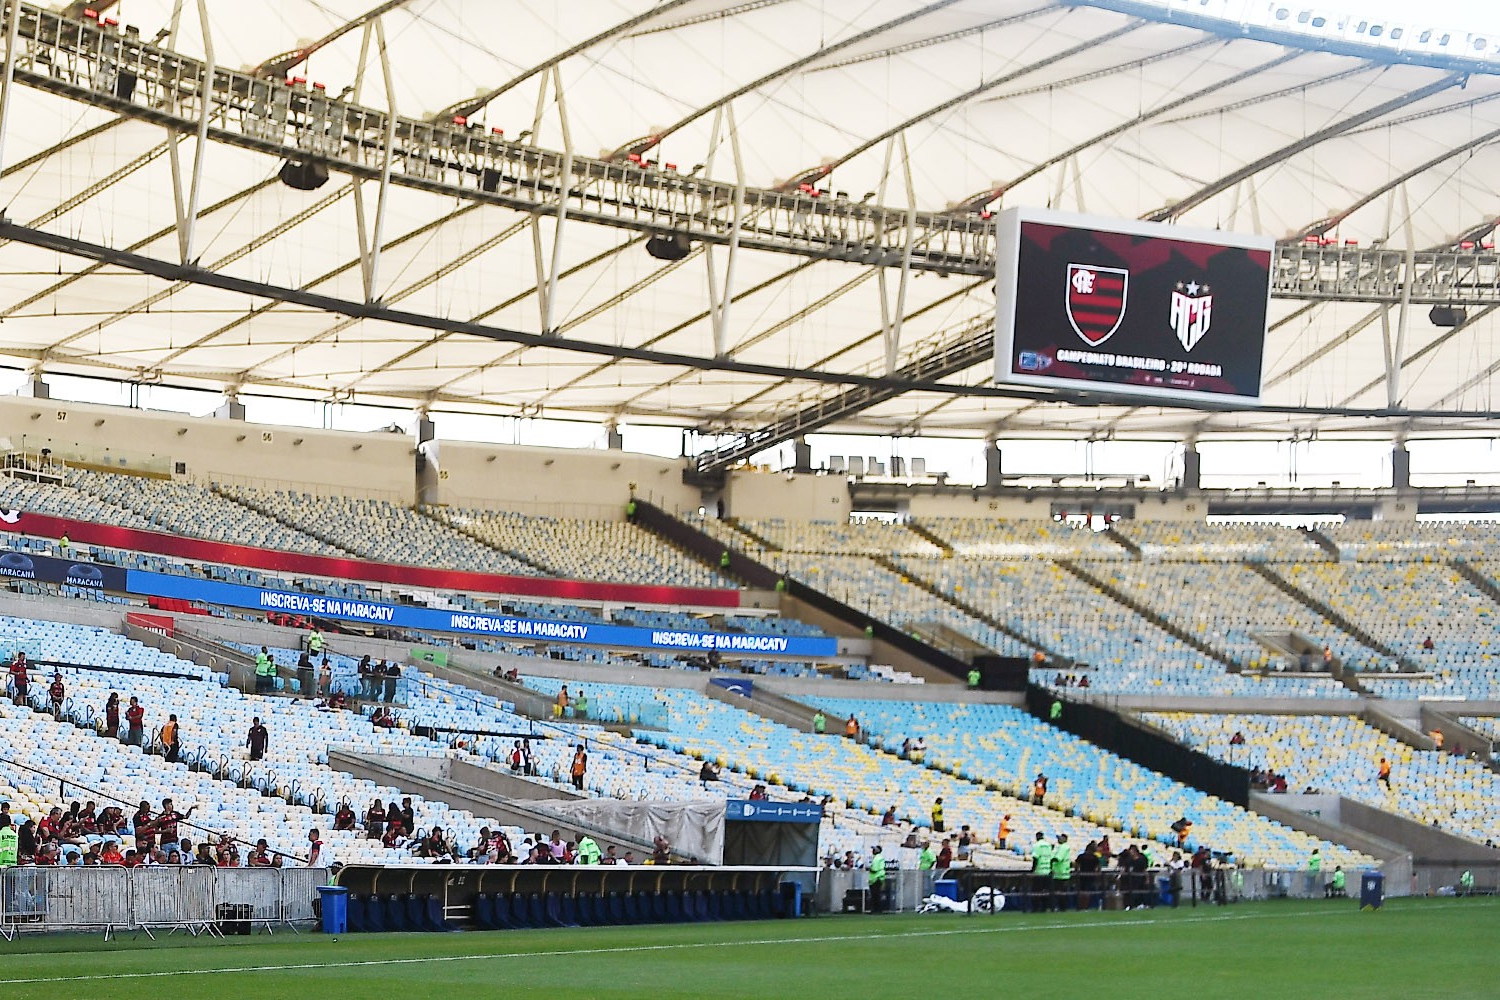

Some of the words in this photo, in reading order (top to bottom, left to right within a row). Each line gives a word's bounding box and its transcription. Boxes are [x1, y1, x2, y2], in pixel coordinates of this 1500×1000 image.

[57, 411, 67, 421] 57
[260, 591, 326, 613] INSCREVA-SE
[327, 601, 342, 614] NA
[342, 602, 394, 621] MARACATV
[451, 614, 517, 635] INSCREVA-SE
[517, 621, 533, 635] NA
[533, 622, 588, 640] MARACATV
[652, 631, 715, 649] INSCREVA-SE
[715, 635, 731, 649] NA
[731, 637, 788, 651] MARACATV
